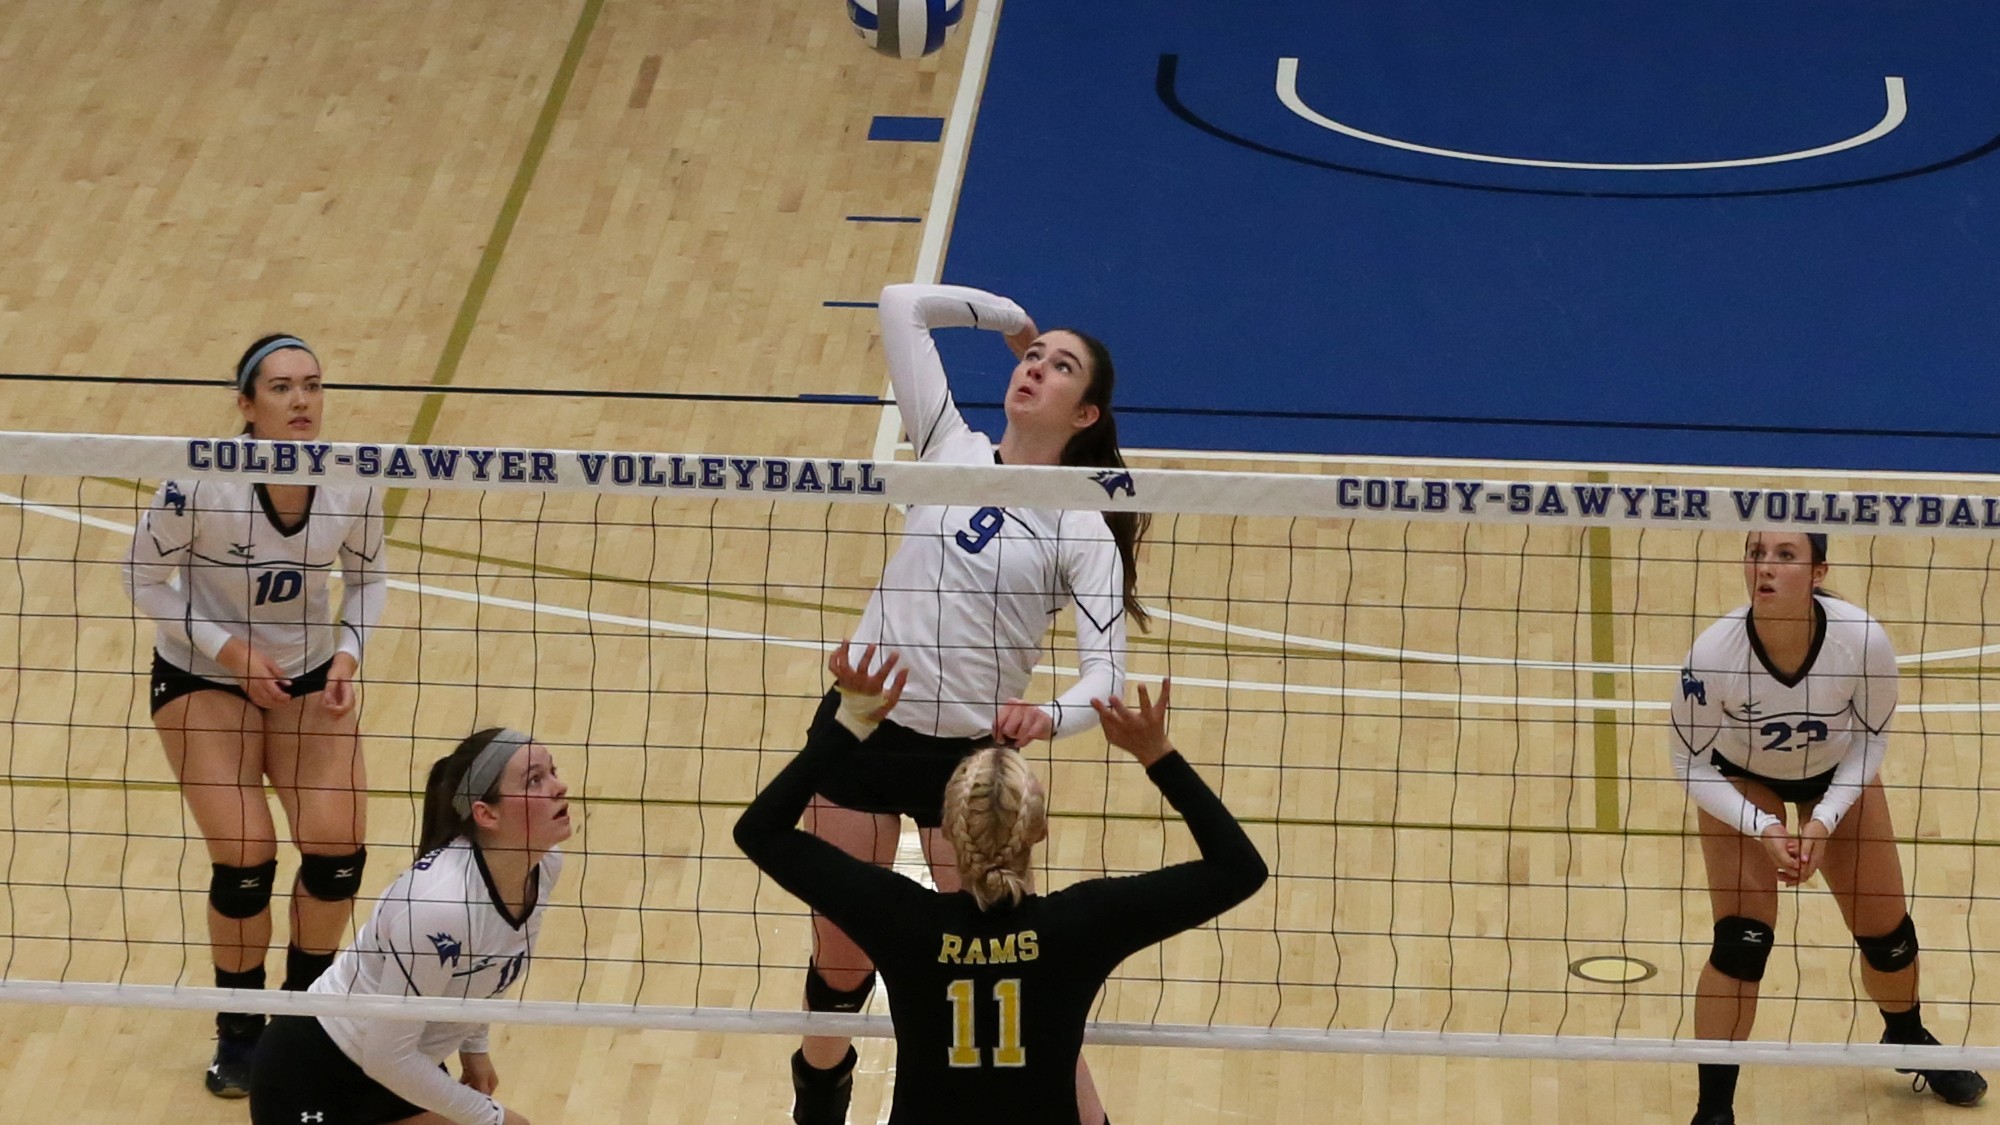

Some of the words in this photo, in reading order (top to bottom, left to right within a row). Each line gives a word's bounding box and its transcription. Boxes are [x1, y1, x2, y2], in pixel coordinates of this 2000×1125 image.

[187, 439, 558, 483] COLBY-SAWYER
[577, 452, 885, 494] VOLLEYBALL
[1336, 478, 1711, 520] COLBY-SAWYER
[956, 506, 1005, 554] 9
[255, 571, 303, 606] 10
[937, 930, 1040, 965] RAMS
[946, 978, 1026, 1068] 11
